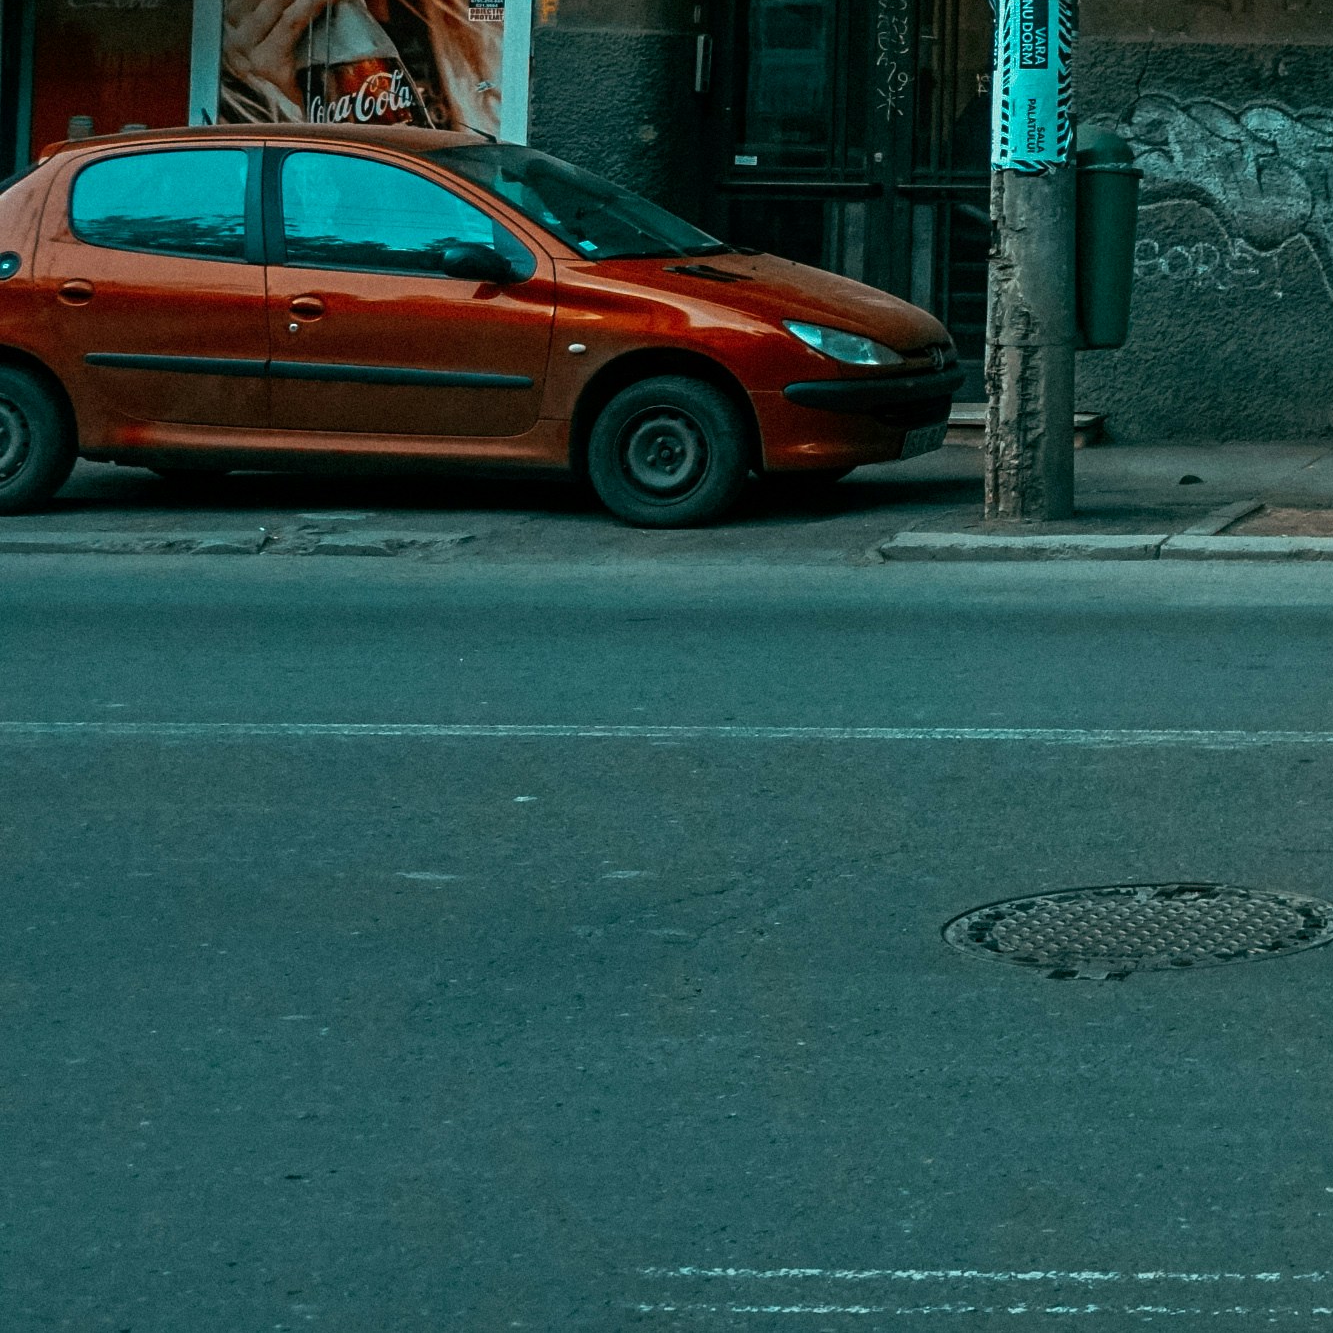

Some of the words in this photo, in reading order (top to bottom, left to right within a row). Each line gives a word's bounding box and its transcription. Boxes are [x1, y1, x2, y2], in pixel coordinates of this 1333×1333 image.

[1021, 0, 1034, 18] NU
[1021, 24, 1034, 66] DORM
[1034, 27, 1047, 66] VARA
[1027, 98, 1037, 155] PALATULUI
[1036, 126, 1046, 154] SALA
